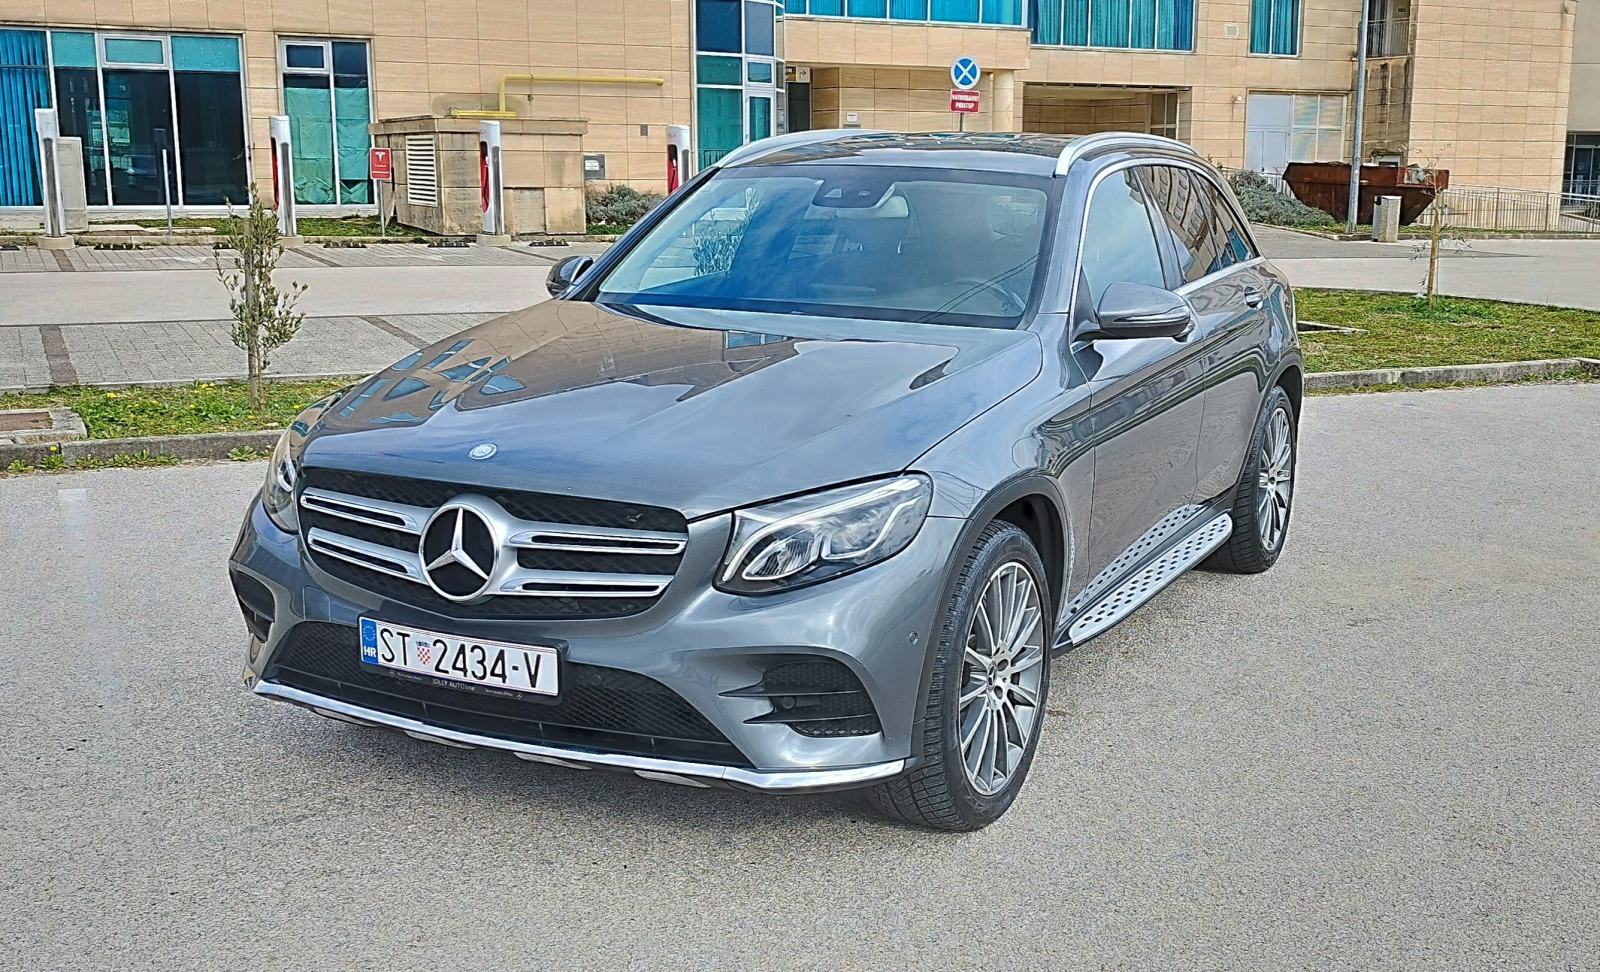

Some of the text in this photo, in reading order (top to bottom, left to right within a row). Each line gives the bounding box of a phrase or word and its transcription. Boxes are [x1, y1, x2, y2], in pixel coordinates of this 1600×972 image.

[363, 645, 377, 657] HR
[380, 628, 541, 688] ST 2434-V
